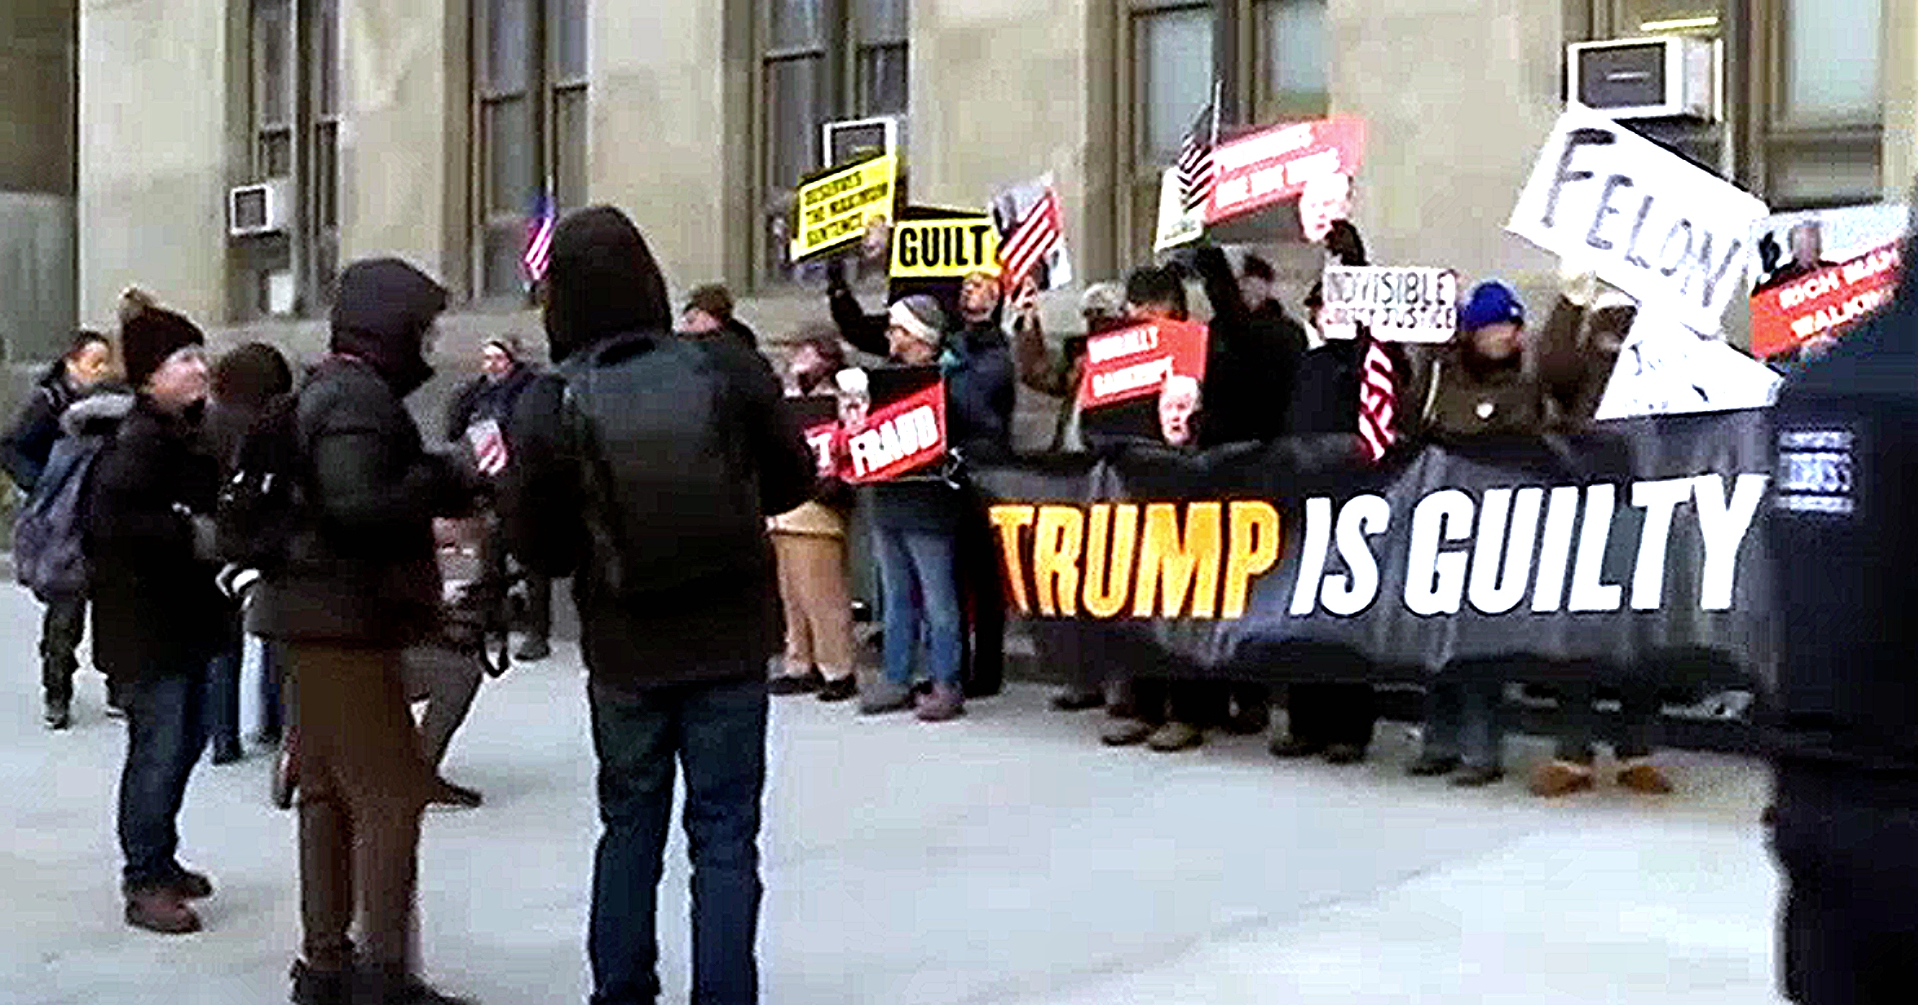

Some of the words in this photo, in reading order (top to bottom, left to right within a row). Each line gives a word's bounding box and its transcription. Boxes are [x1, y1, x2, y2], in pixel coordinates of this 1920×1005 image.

[1540, 128, 1741, 307] FELON
[1779, 271, 1840, 309] RICH
[849, 405, 938, 477] FRAUD
[988, 500, 1280, 619] TRUMP
[1289, 495, 1391, 617] IS
[1404, 474, 1770, 615] GUILTY
